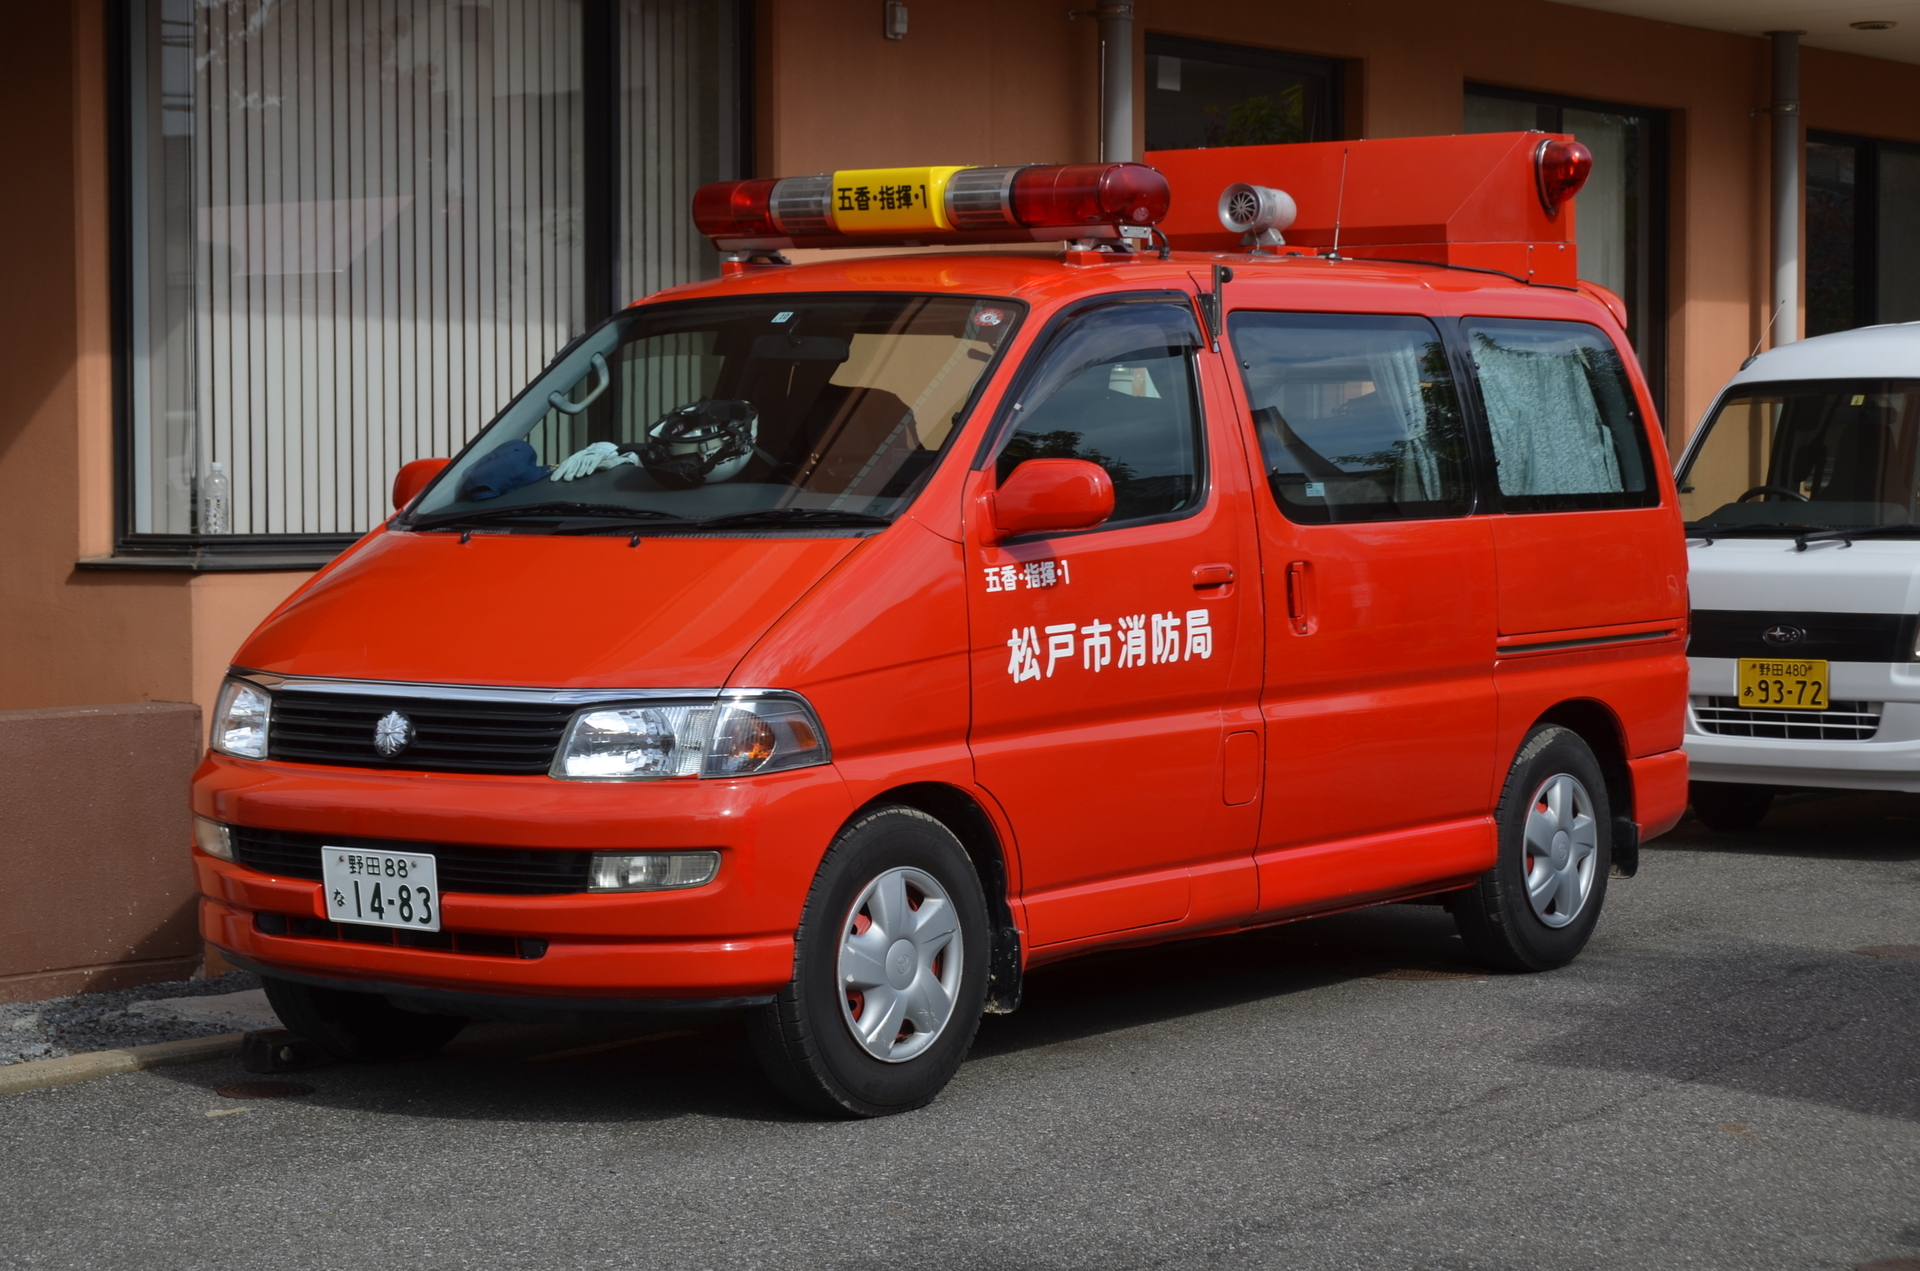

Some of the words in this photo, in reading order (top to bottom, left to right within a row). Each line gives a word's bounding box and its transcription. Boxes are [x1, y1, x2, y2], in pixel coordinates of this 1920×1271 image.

[1007, 608, 1212, 684] 松戸市消防局
[1743, 685, 1755, 698] あ
[1757, 679, 1823, 706] 93-72
[333, 888, 346, 908] な
[353, 880, 433, 925] 14-83
